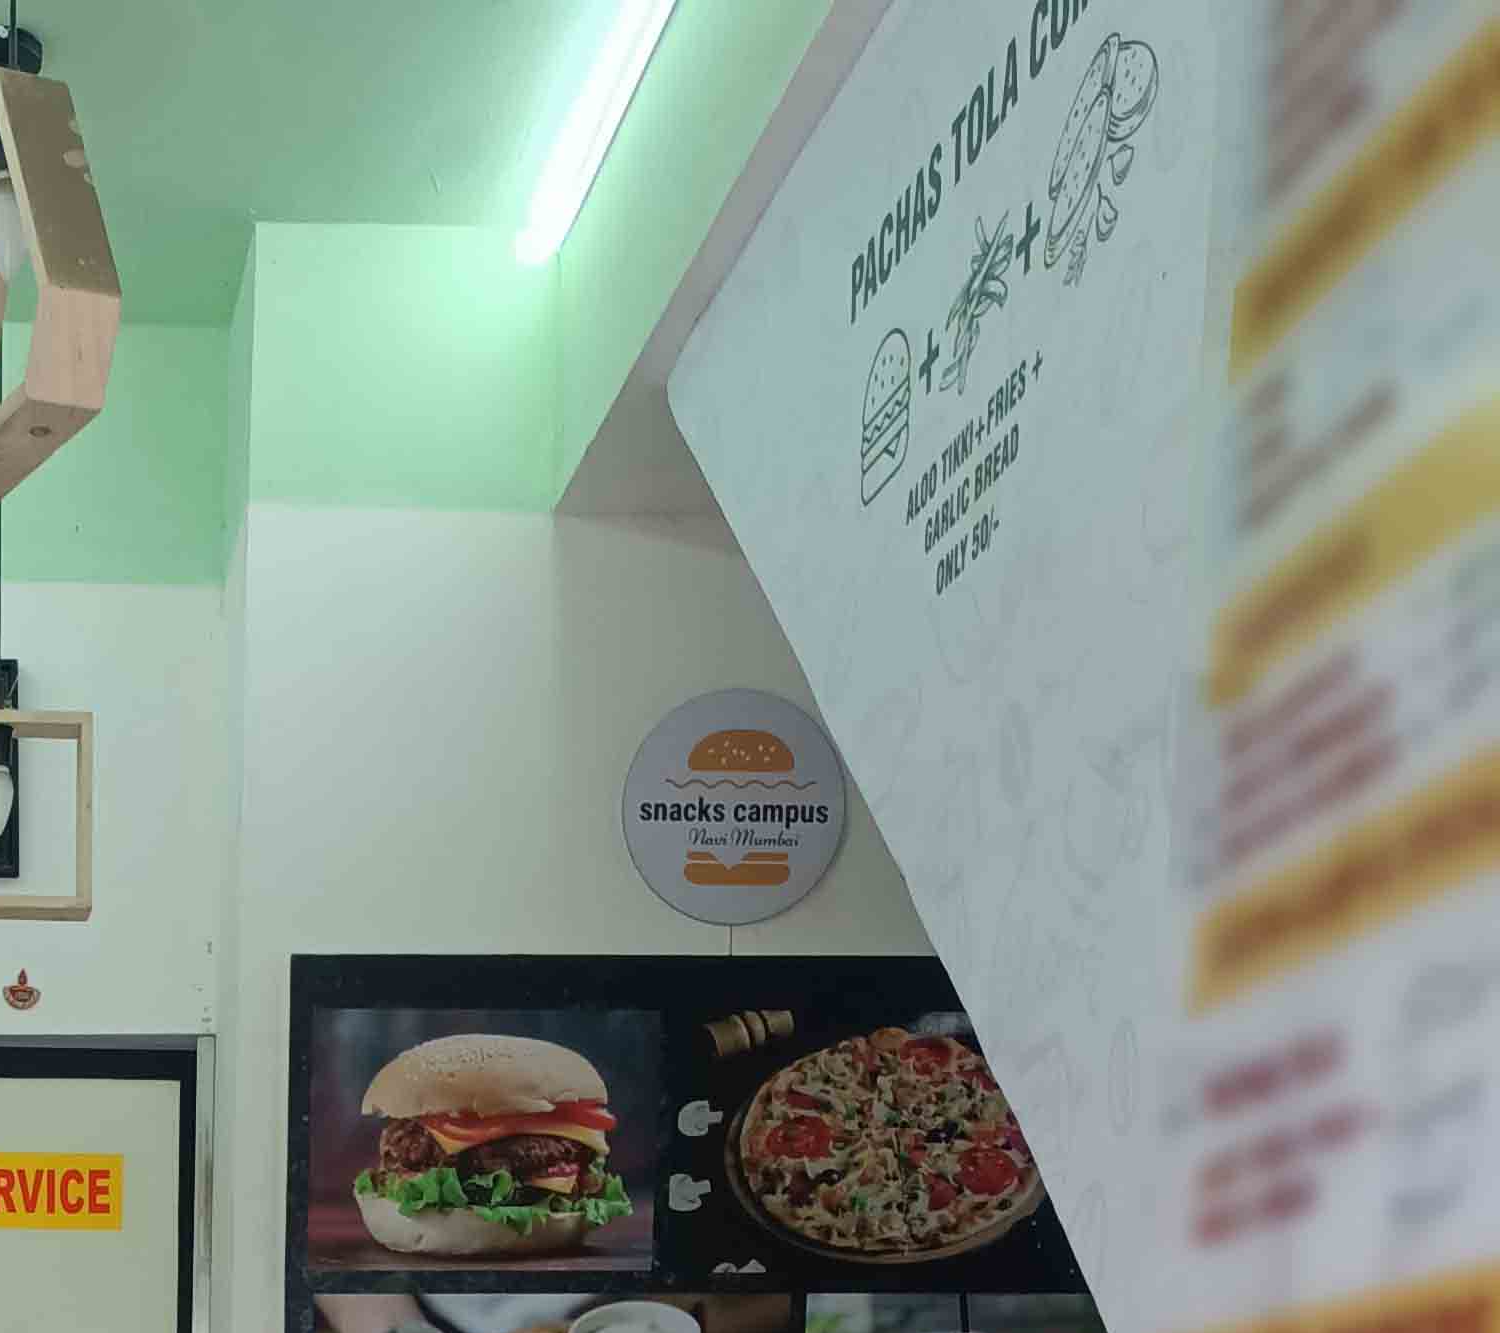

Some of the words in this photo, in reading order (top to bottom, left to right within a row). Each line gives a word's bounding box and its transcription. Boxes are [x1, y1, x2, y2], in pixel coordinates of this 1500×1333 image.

[850, 142, 943, 326] PACHAS
[951, 36, 1018, 188] TOLA
[1029, 0, 1089, 79] CO
[906, 462, 938, 527] ALOO
[924, 476, 970, 555] GARLIC
[974, 423, 1020, 503] BREAD
[935, 532, 969, 596] ONLY
[638, 796, 726, 823] snacks
[733, 802, 829, 829] campus
[688, 827, 728, 847] Navi
[729, 829, 800, 848] Mumbai
